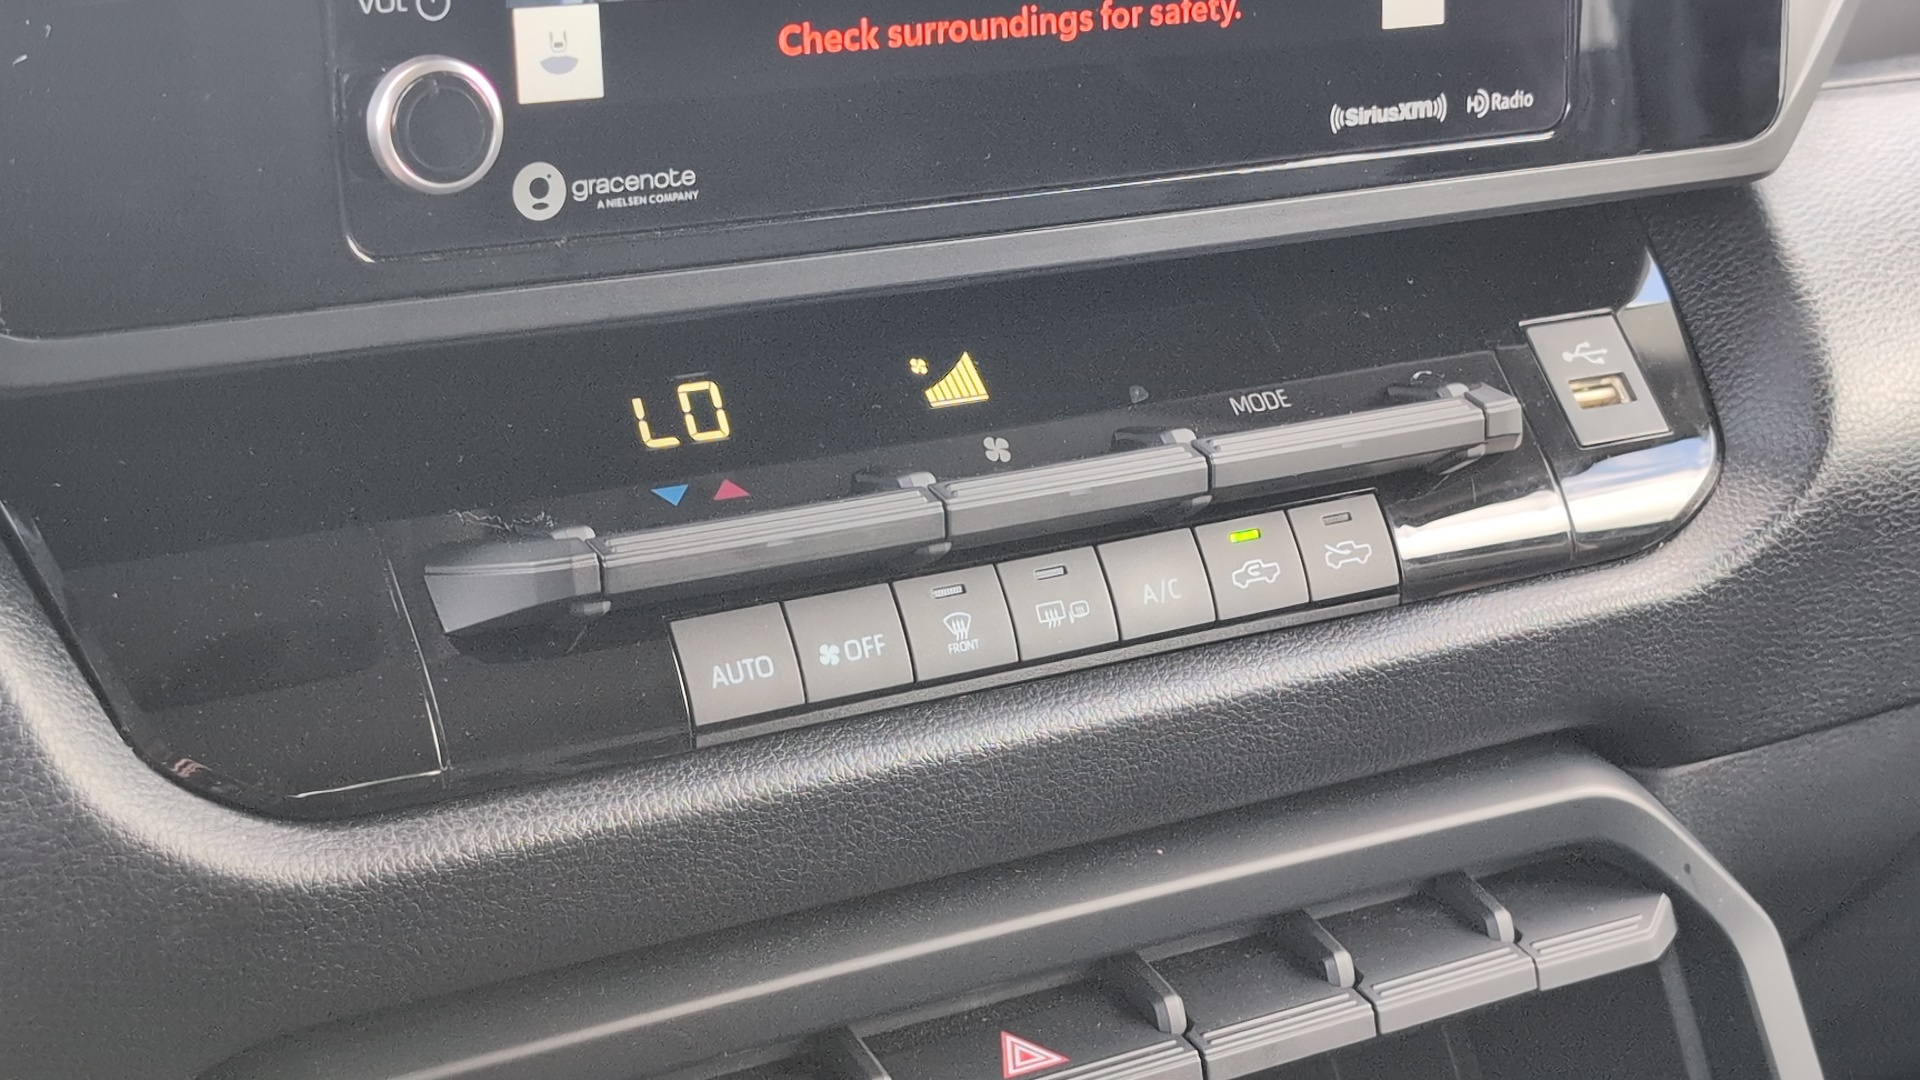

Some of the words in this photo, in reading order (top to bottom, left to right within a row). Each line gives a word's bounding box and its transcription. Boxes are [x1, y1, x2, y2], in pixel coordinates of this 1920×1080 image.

[777, 17, 880, 57] Check
[887, 4, 1094, 49] surroundings
[1100, 0, 1143, 31] for
[1149, 0, 1243, 29] safety.
[1490, 89, 1534, 111] Radio
[571, 167, 697, 202] gracenote
[596, 198, 606, 210] A
[606, 195, 647, 210] NIELSEN
[649, 189, 700, 204] COMPANY
[1228, 388, 1293, 417] MODE
[1143, 578, 1182, 606] A/C
[843, 633, 887, 663] OFF
[947, 638, 979, 655] FRONT
[711, 654, 775, 690] AUTO
